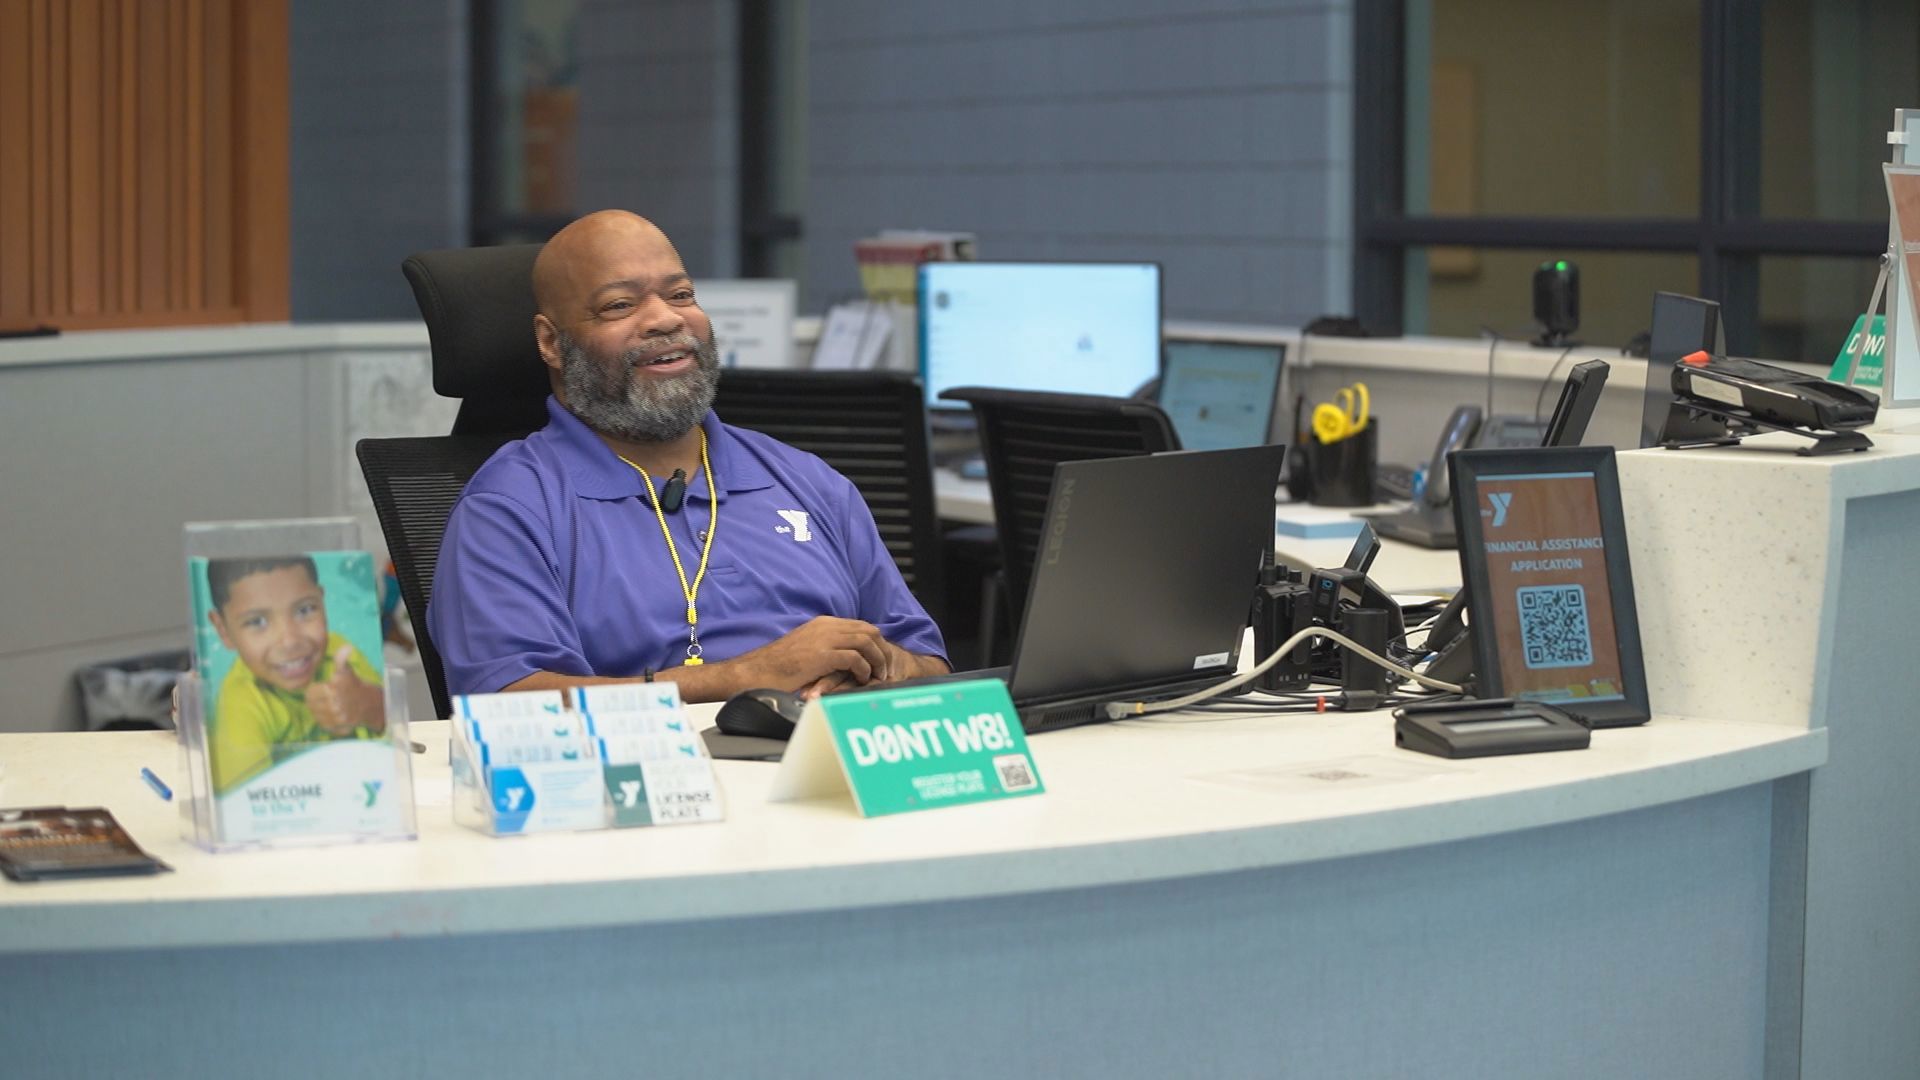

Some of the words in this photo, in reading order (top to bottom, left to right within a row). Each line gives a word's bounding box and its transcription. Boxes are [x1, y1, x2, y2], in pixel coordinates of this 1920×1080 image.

[1047, 479, 1076, 565] LEGION
[1541, 537, 1604, 551] ASSISTANC
[1511, 558, 1583, 572] APPLICATION
[943, 712, 1014, 753] W8!
[247, 784, 323, 801] WELCOME
[656, 791, 712, 804] LICENSE
[660, 805, 701, 818] PLATE
